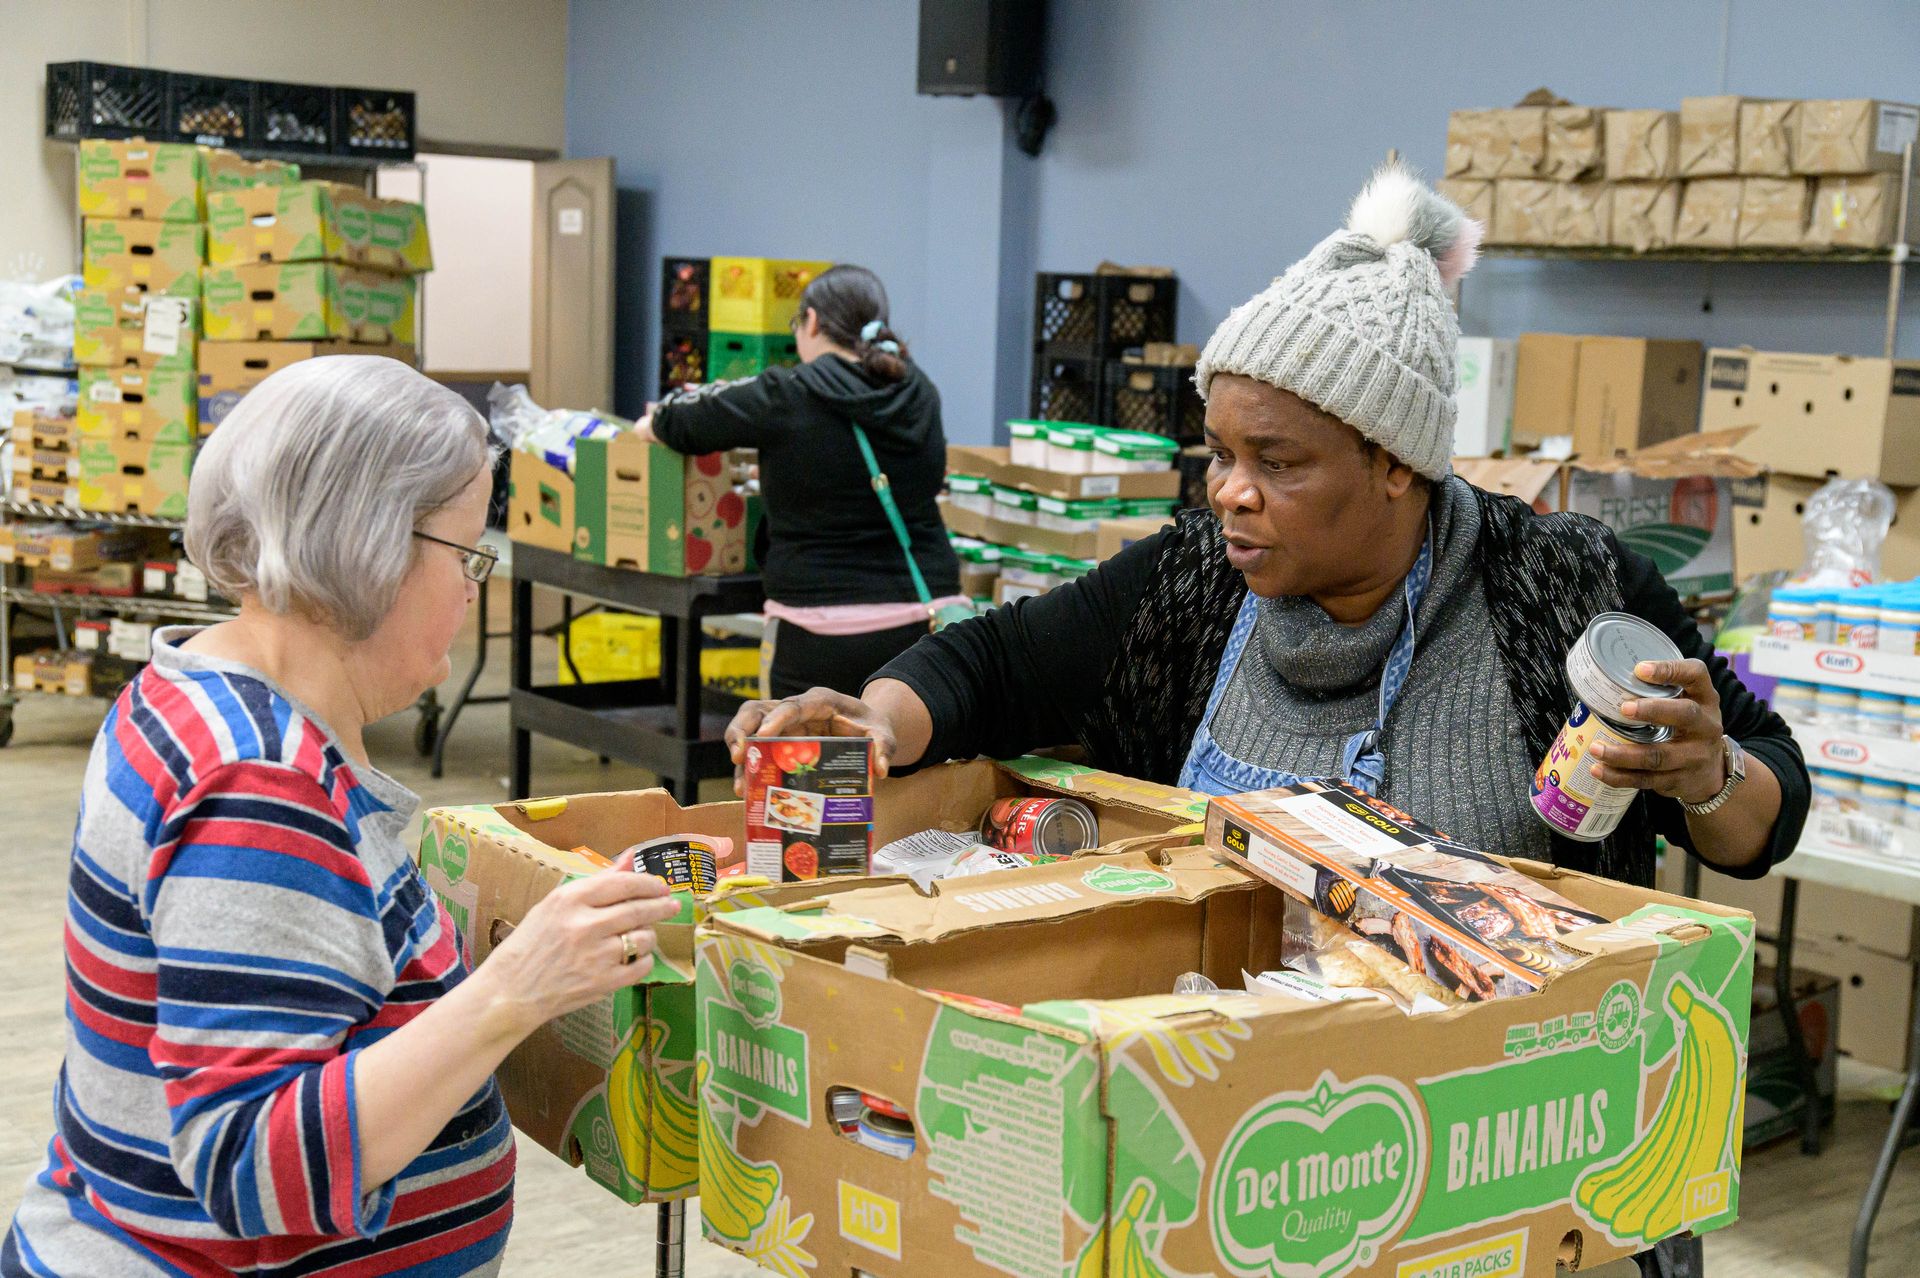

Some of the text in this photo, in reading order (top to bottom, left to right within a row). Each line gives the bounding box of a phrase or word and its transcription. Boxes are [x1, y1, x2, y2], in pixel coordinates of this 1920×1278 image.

[1825, 655, 1853, 669] Kraft
[1831, 744, 1858, 758] Kraft
[1365, 813, 1400, 835] GOLD
[1226, 836, 1245, 851] GOLD
[953, 882, 1084, 913] BANANAS
[717, 1030, 798, 1097] BANANAS
[1446, 1088, 1609, 1193] BANANAS
[1235, 1139, 1403, 1217] Del Monte
[1693, 1181, 1721, 1208] HD
[850, 1197, 887, 1235] HD
[1281, 1207, 1352, 1243] Quality
[1464, 1250, 1512, 1278] PACKS
